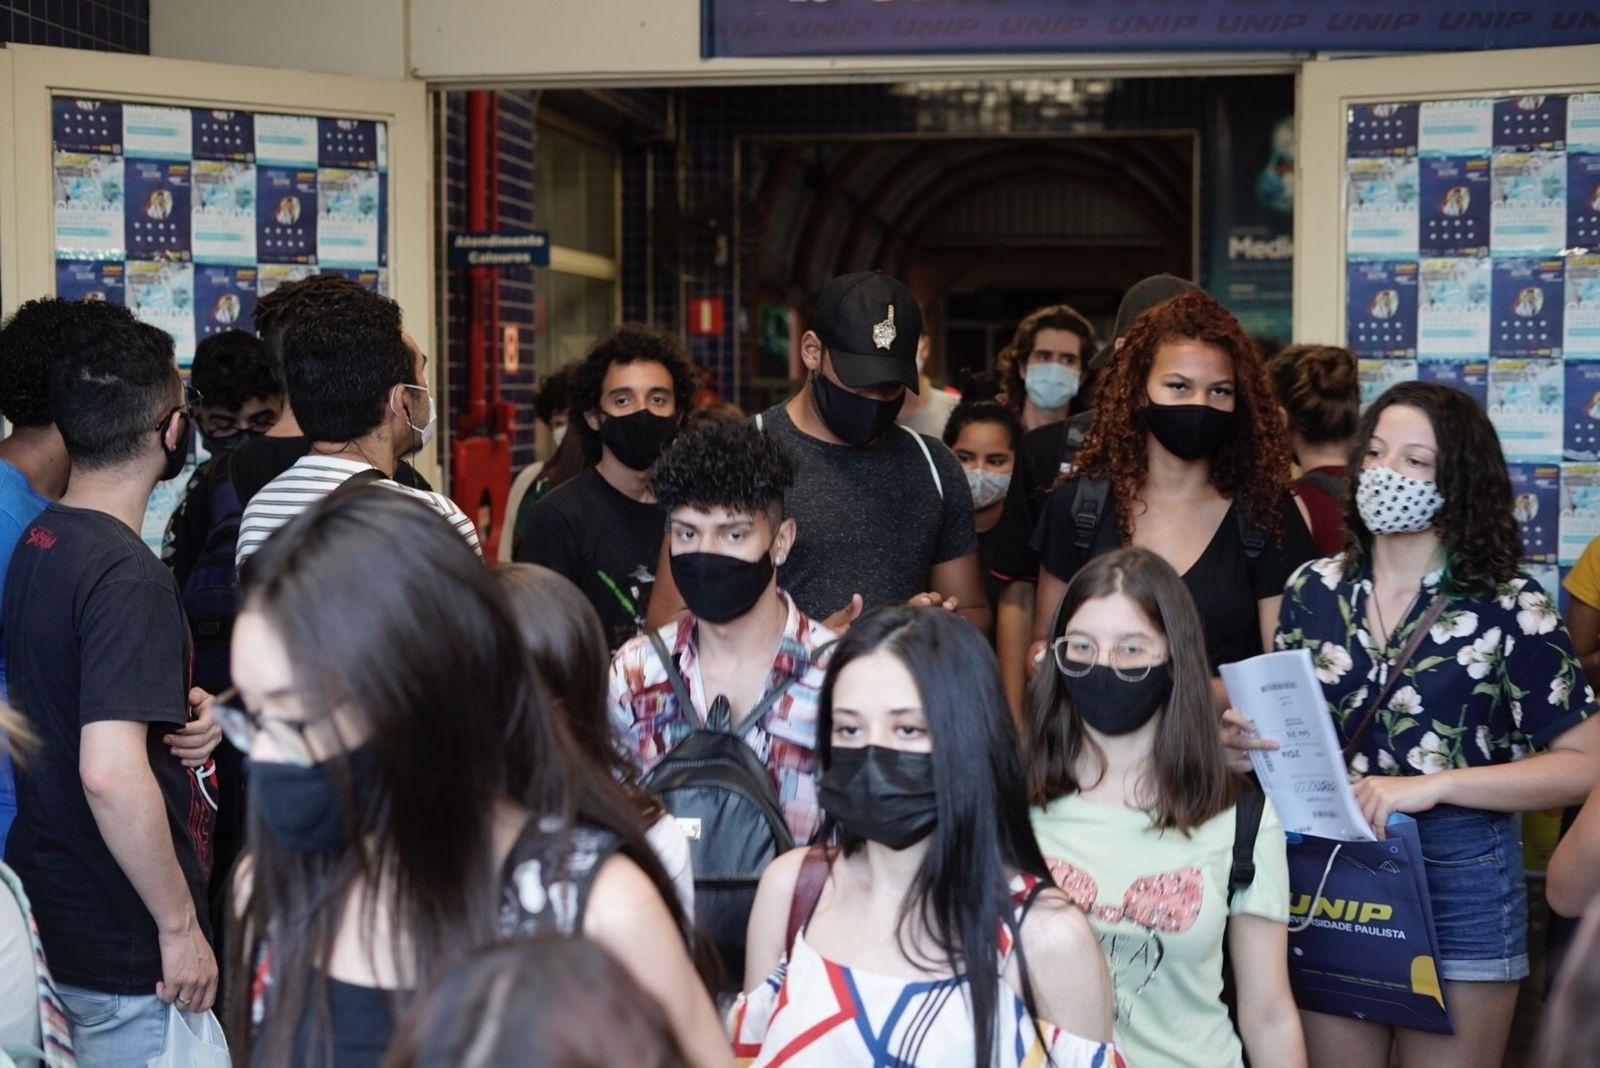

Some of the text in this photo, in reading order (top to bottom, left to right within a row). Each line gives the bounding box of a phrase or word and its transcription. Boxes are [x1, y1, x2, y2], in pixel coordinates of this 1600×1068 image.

[786, 18, 874, 38] UNIP
[892, 17, 982, 36] UNIP
[998, 16, 1089, 35] UNIP
[1105, 14, 1200, 34] UNIP
[1216, 13, 1309, 33] UNIP
[1325, 11, 1420, 32] UNIP
[1438, 10, 1533, 30] UNIP
[1289, 893, 1393, 924] UNIP
[1354, 924, 1406, 940] PAULISTA
